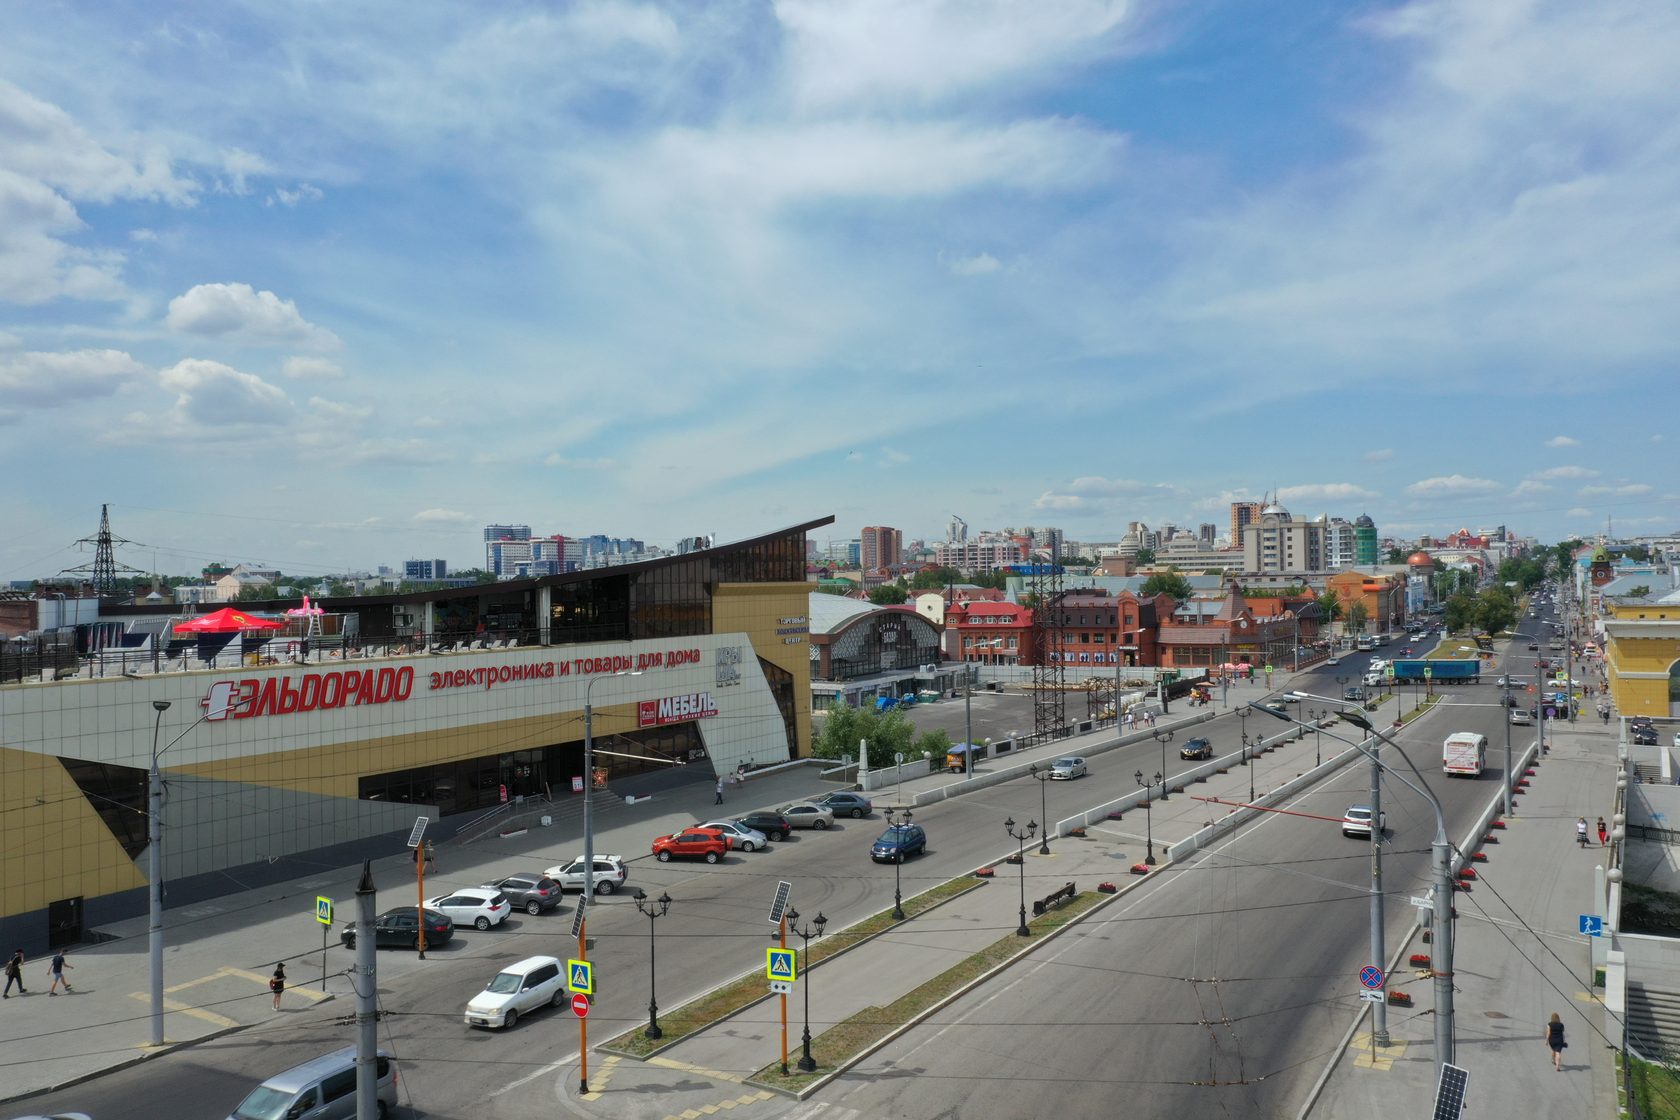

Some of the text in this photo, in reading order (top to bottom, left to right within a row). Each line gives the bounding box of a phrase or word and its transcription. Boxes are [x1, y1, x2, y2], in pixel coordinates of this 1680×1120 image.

[430, 648, 701, 691] электроника и товары для дома
[659, 692, 716, 718] МЕБЕЛЬ
